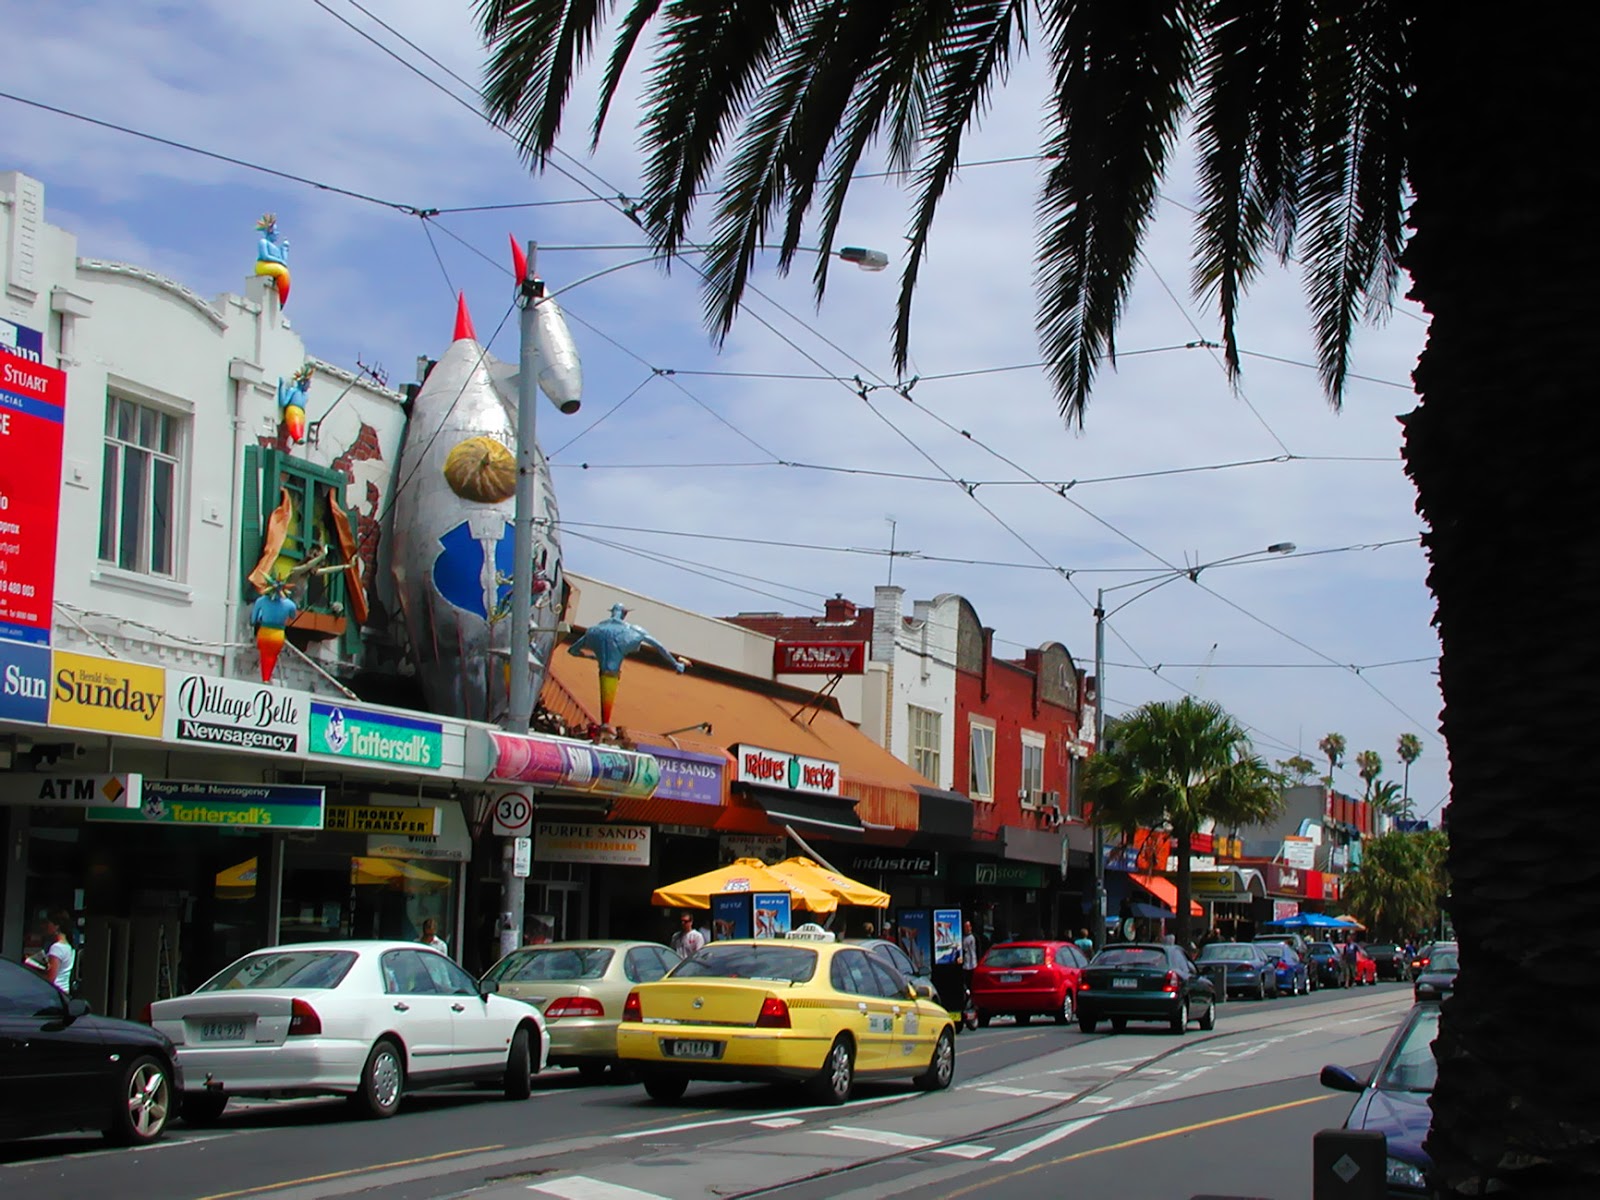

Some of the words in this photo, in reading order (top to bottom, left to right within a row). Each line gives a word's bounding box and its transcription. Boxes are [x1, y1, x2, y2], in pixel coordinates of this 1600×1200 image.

[4, 363, 48, 393] STUART
[785, 646, 856, 667] TANDY
[4, 664, 47, 699] Sun
[55, 669, 163, 721] Sunday
[179, 676, 251, 723] Village
[253, 690, 299, 727] Belle
[183, 721, 294, 752] Newsagency
[350, 726, 430, 764] Tattersall's
[679, 763, 717, 779] SANDS
[745, 752, 785, 781] natures
[803, 764, 836, 791] nectar
[39, 778, 95, 800] ATM
[144, 782, 178, 793] Village
[181, 783, 204, 794] Belle
[208, 785, 270, 797] Newsagency
[172, 804, 271, 824] Tattersall's
[358, 810, 404, 820] MONEY
[500, 802, 526, 820] 30
[357, 820, 425, 831] TRANSFER
[540, 824, 594, 838] PURPLE
[598, 827, 647, 841] SANDS
[852, 857, 931, 871] industrie
[998, 868, 1027, 879] store
